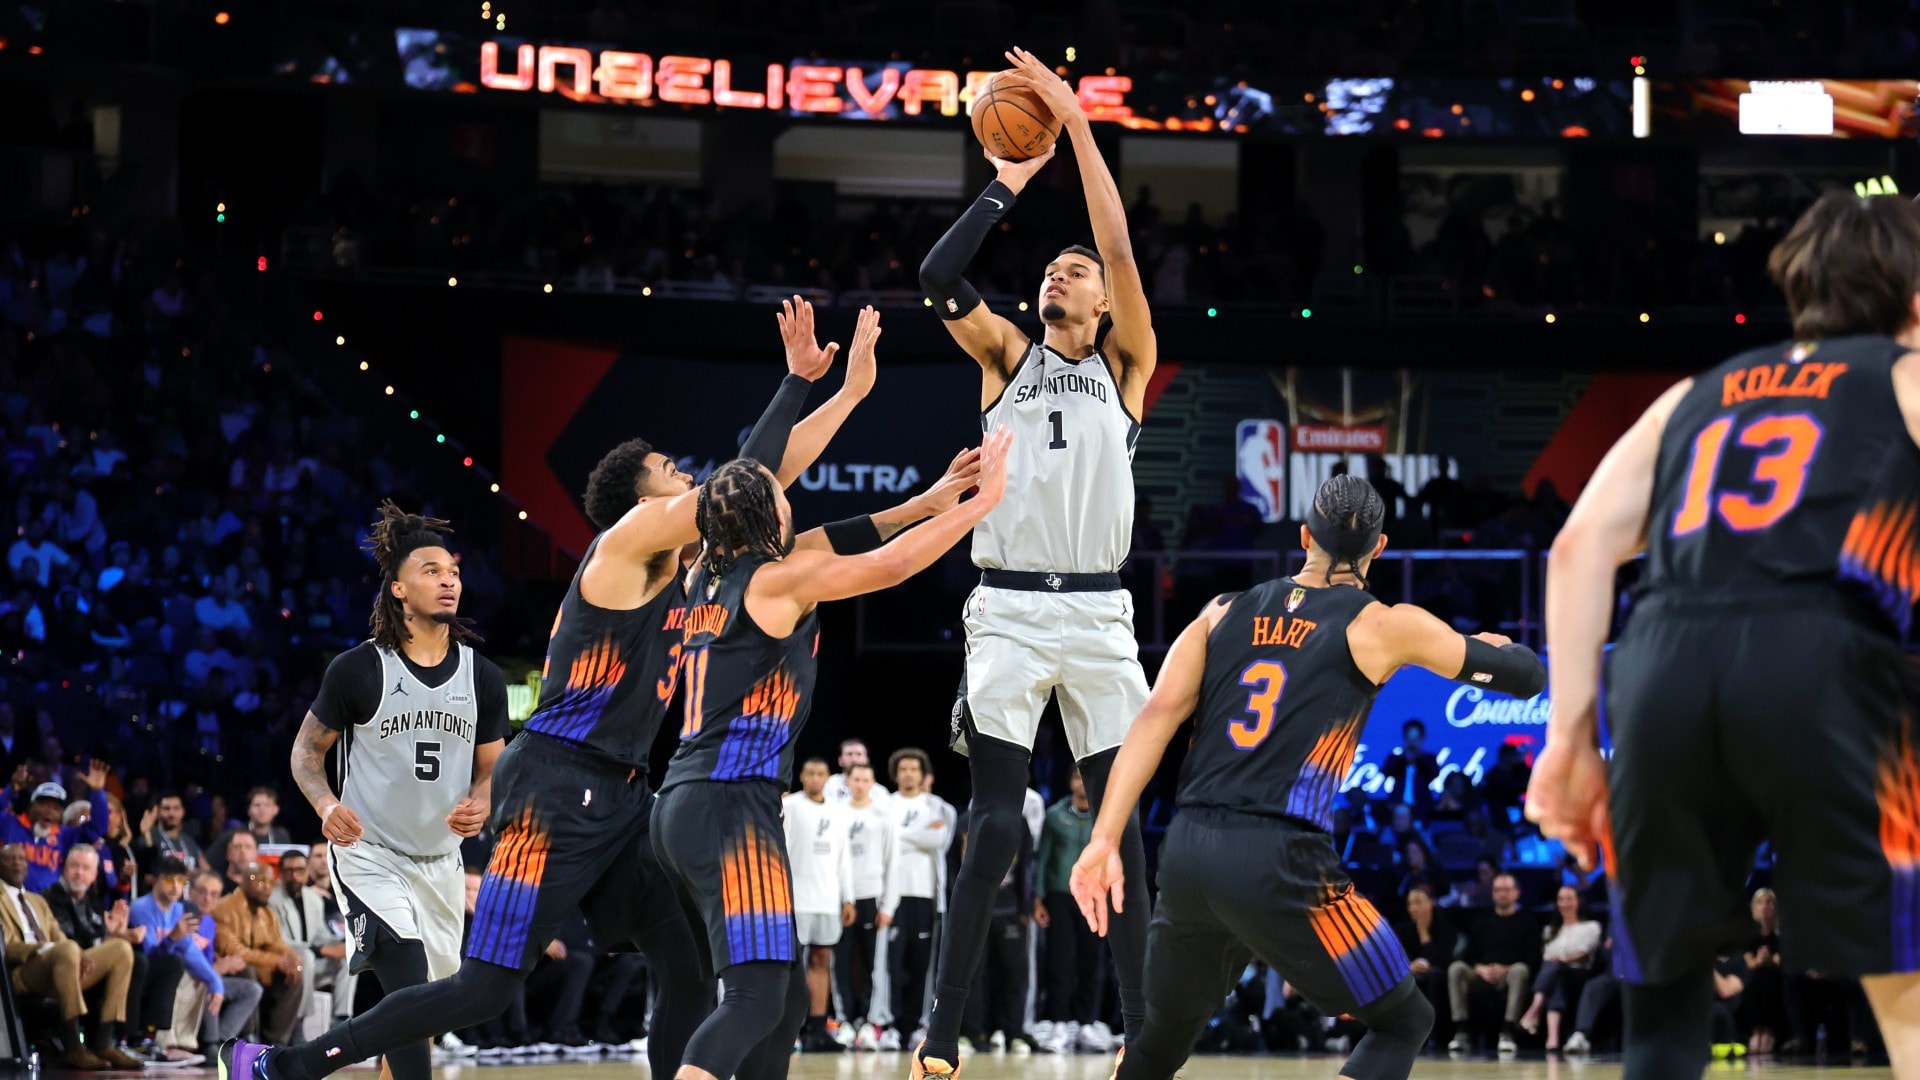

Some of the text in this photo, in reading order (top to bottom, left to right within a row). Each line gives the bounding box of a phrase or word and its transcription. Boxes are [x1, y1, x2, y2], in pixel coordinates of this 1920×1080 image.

[480, 41, 1133, 122] UNBELIEVAE
[1721, 362, 1849, 407] KOLEK
[1047, 409, 1068, 450] 1
[1297, 426, 1382, 448] Emirates
[799, 463, 920, 492] ULTRA
[1671, 411, 1826, 539] 13
[1252, 616, 1317, 649] HART
[679, 645, 709, 739] 11
[1226, 658, 1288, 751] 3
[380, 709, 474, 744] SAN ANTONIO
[414, 740, 442, 782] 5
